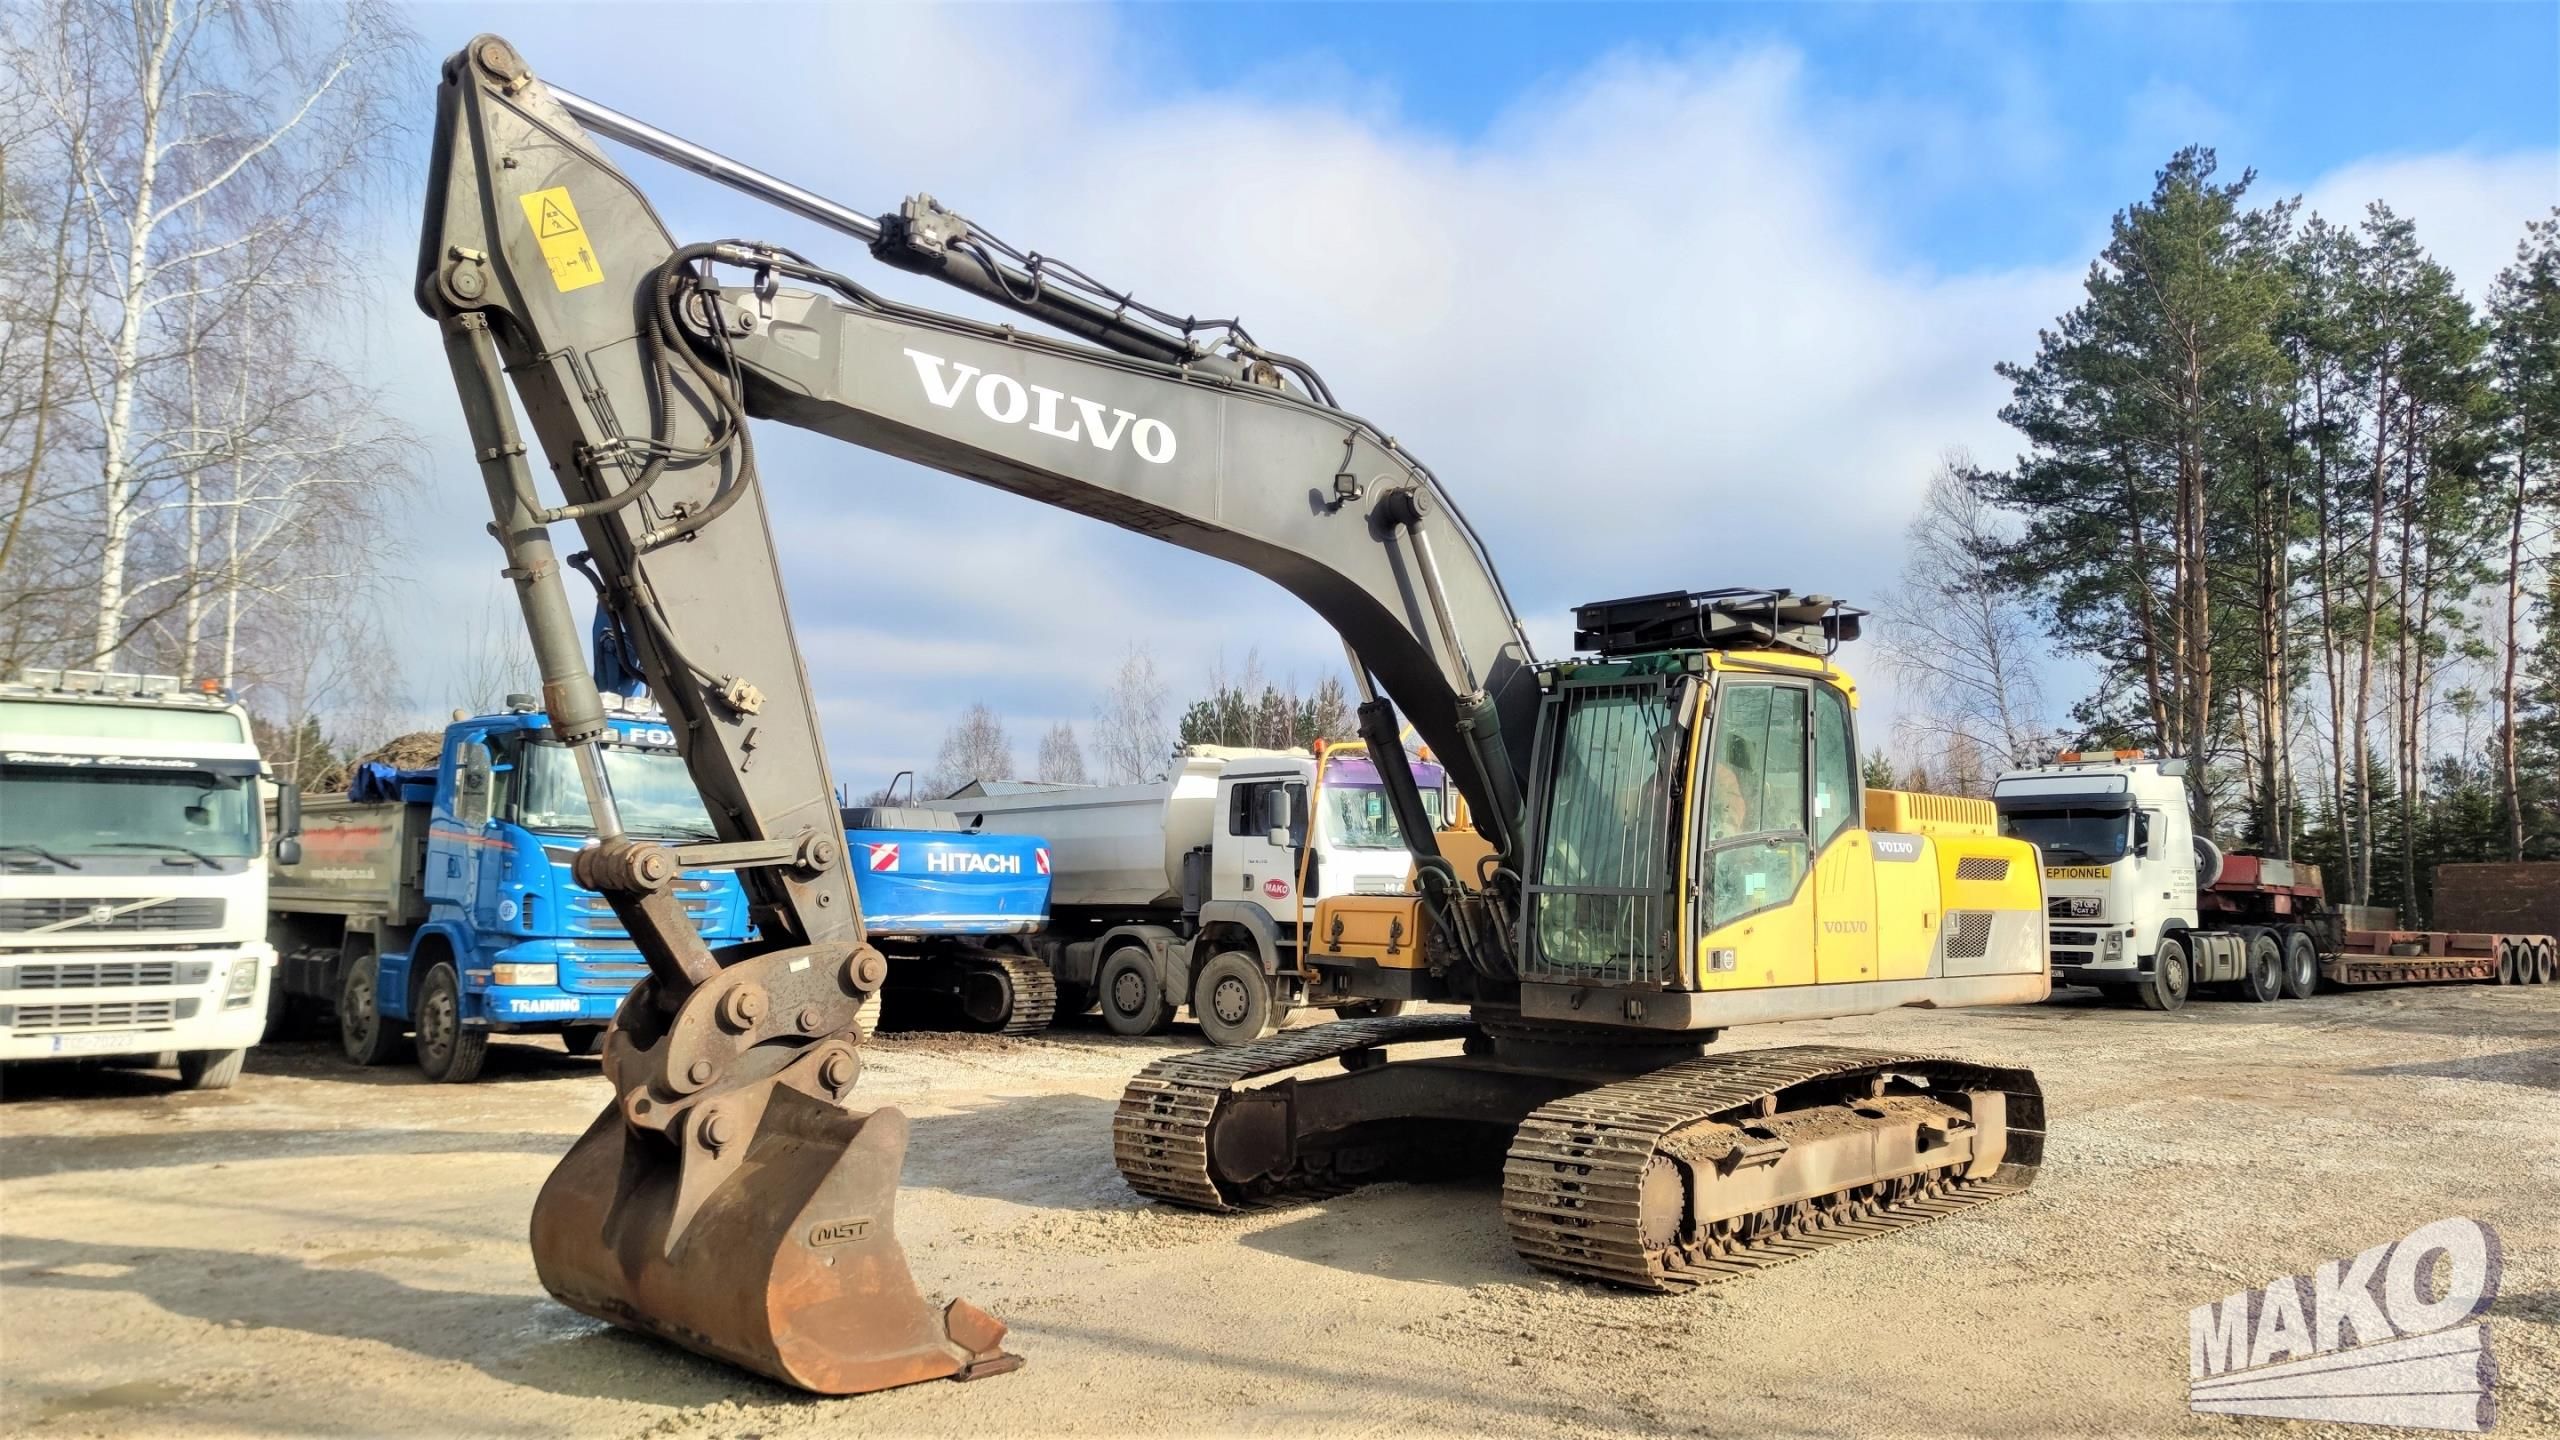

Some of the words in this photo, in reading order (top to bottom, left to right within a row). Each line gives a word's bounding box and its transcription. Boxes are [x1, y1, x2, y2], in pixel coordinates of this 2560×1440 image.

[904, 347, 1177, 464] VOLVO
[1877, 841, 1913, 854] VOLVO
[927, 852, 1021, 874] HITACHI
[2046, 867, 2109, 879] EPTIONNEL
[1265, 882, 1289, 895] MAKO
[1384, 882, 1405, 892] MA
[1823, 920, 1868, 934] VOLVO
[510, 998, 580, 1013] TRAINING
[817, 1221, 869, 1242] MST
